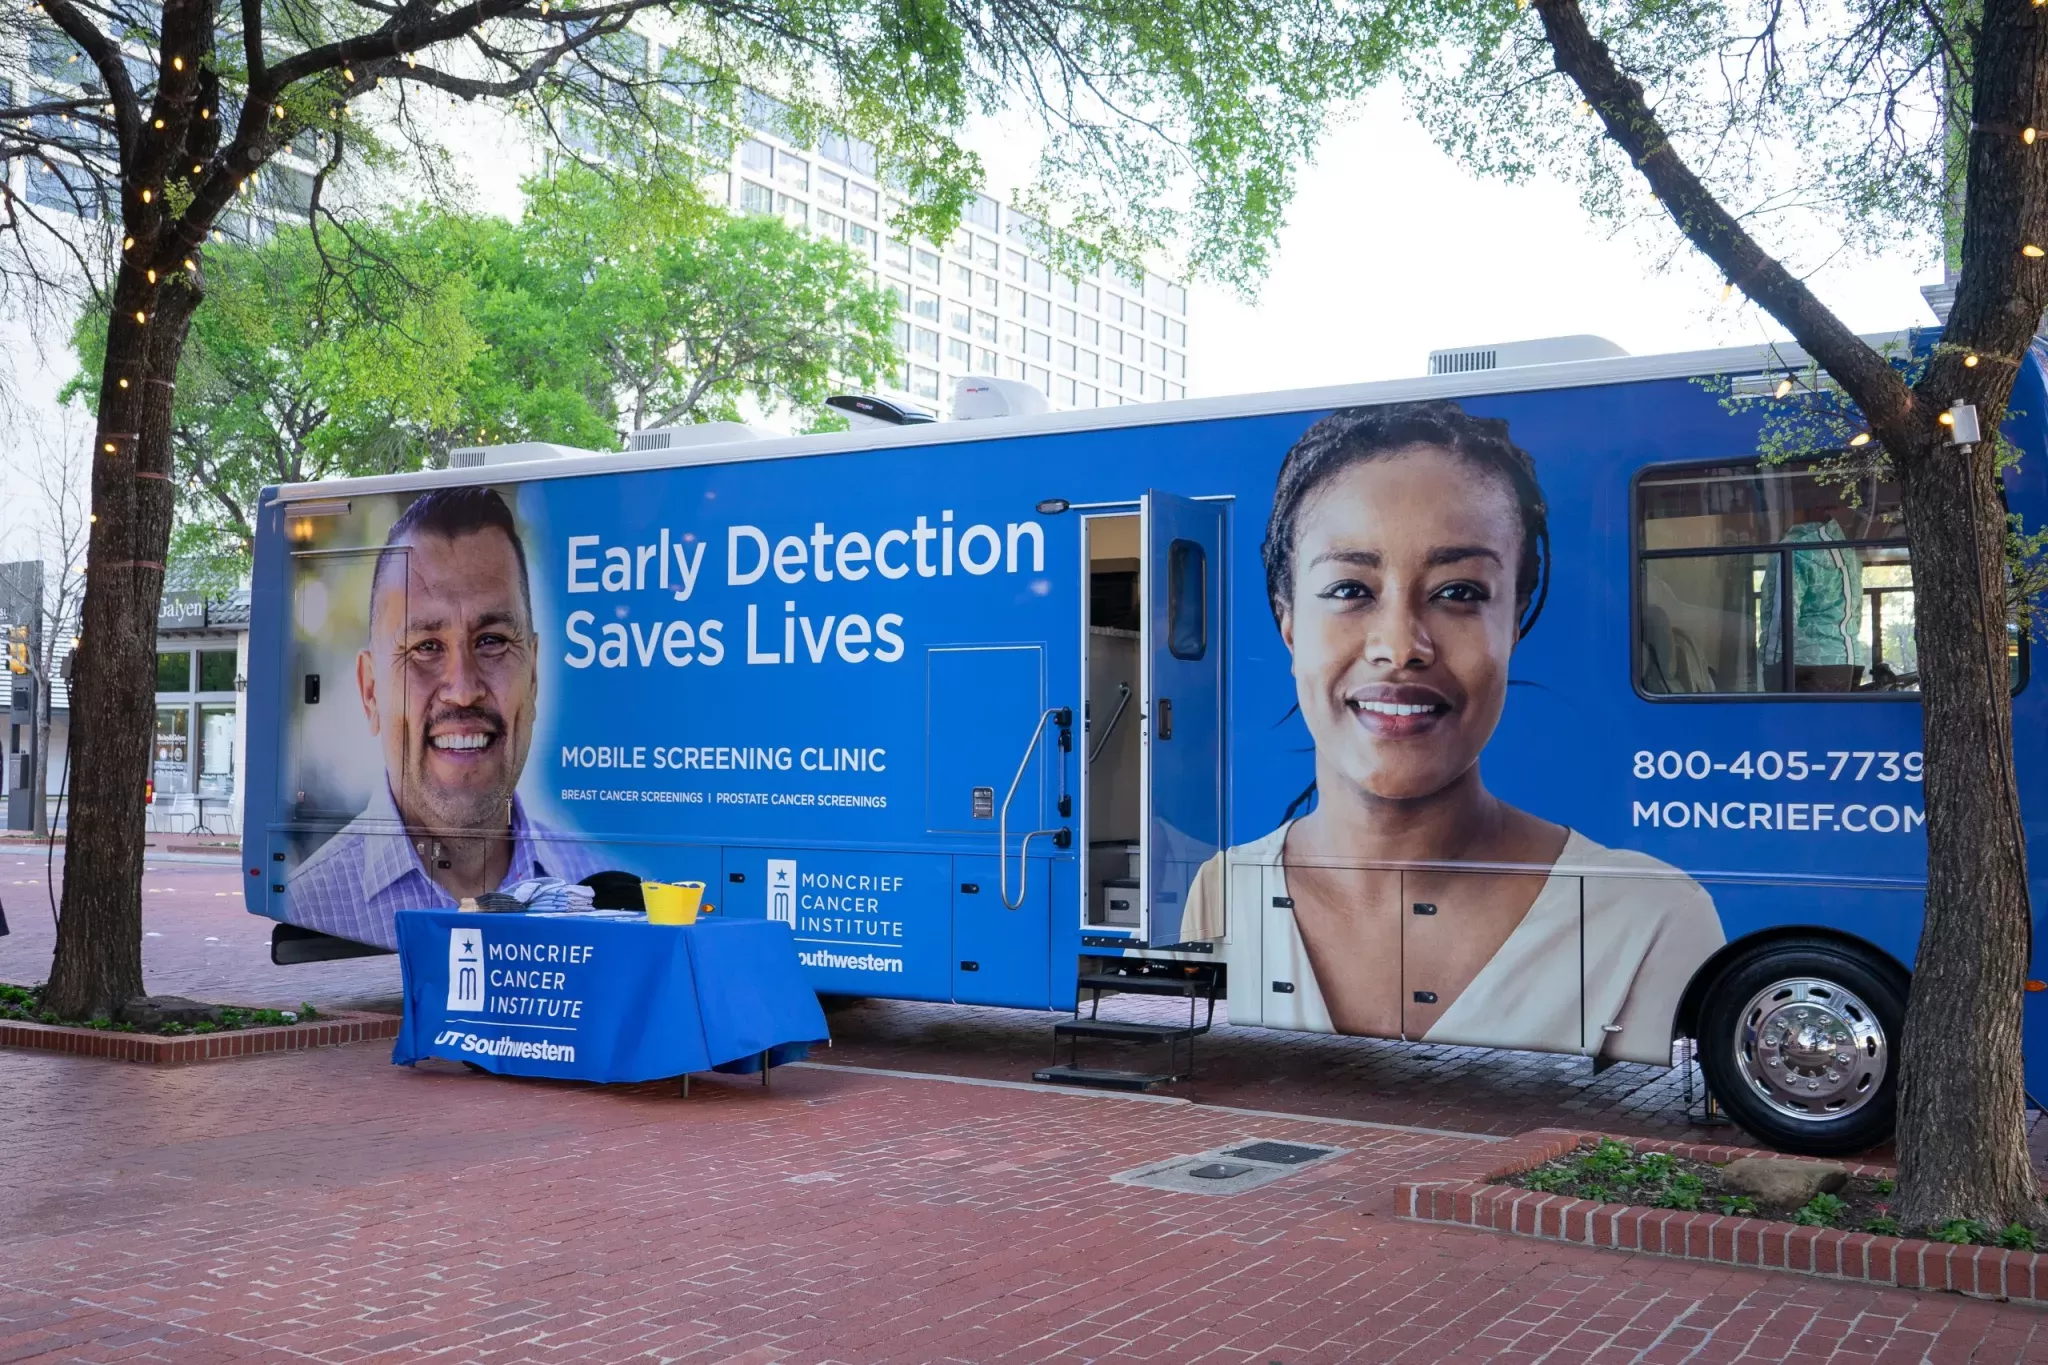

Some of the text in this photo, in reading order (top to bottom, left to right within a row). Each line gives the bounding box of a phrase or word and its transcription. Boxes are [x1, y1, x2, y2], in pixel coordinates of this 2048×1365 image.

[567, 510, 1045, 602] Early Detection
[564, 600, 905, 669] Saves Lives
[562, 746, 886, 773] MOBILE SCREENING CLINIC
[1632, 750, 1924, 782] 800-405-7739
[561, 789, 598, 802] BREAST
[599, 790, 639, 803] CANCER
[640, 791, 704, 804] SCREENINGS
[716, 792, 769, 805] PROSTATE
[770, 793, 815, 806] CANCER
[817, 794, 887, 808] SCREENINGS
[1632, 800, 1926, 833] MONCRIEF.COM
[802, 872, 904, 892] MONCRIEF
[801, 894, 879, 914] CANCER
[801, 916, 903, 938] INSTITUTE
[489, 943, 594, 964] MONCRIEF
[798, 949, 903, 973] outhwestern
[490, 969, 566, 990] CANCER
[490, 996, 583, 1019] INSTITUTE
